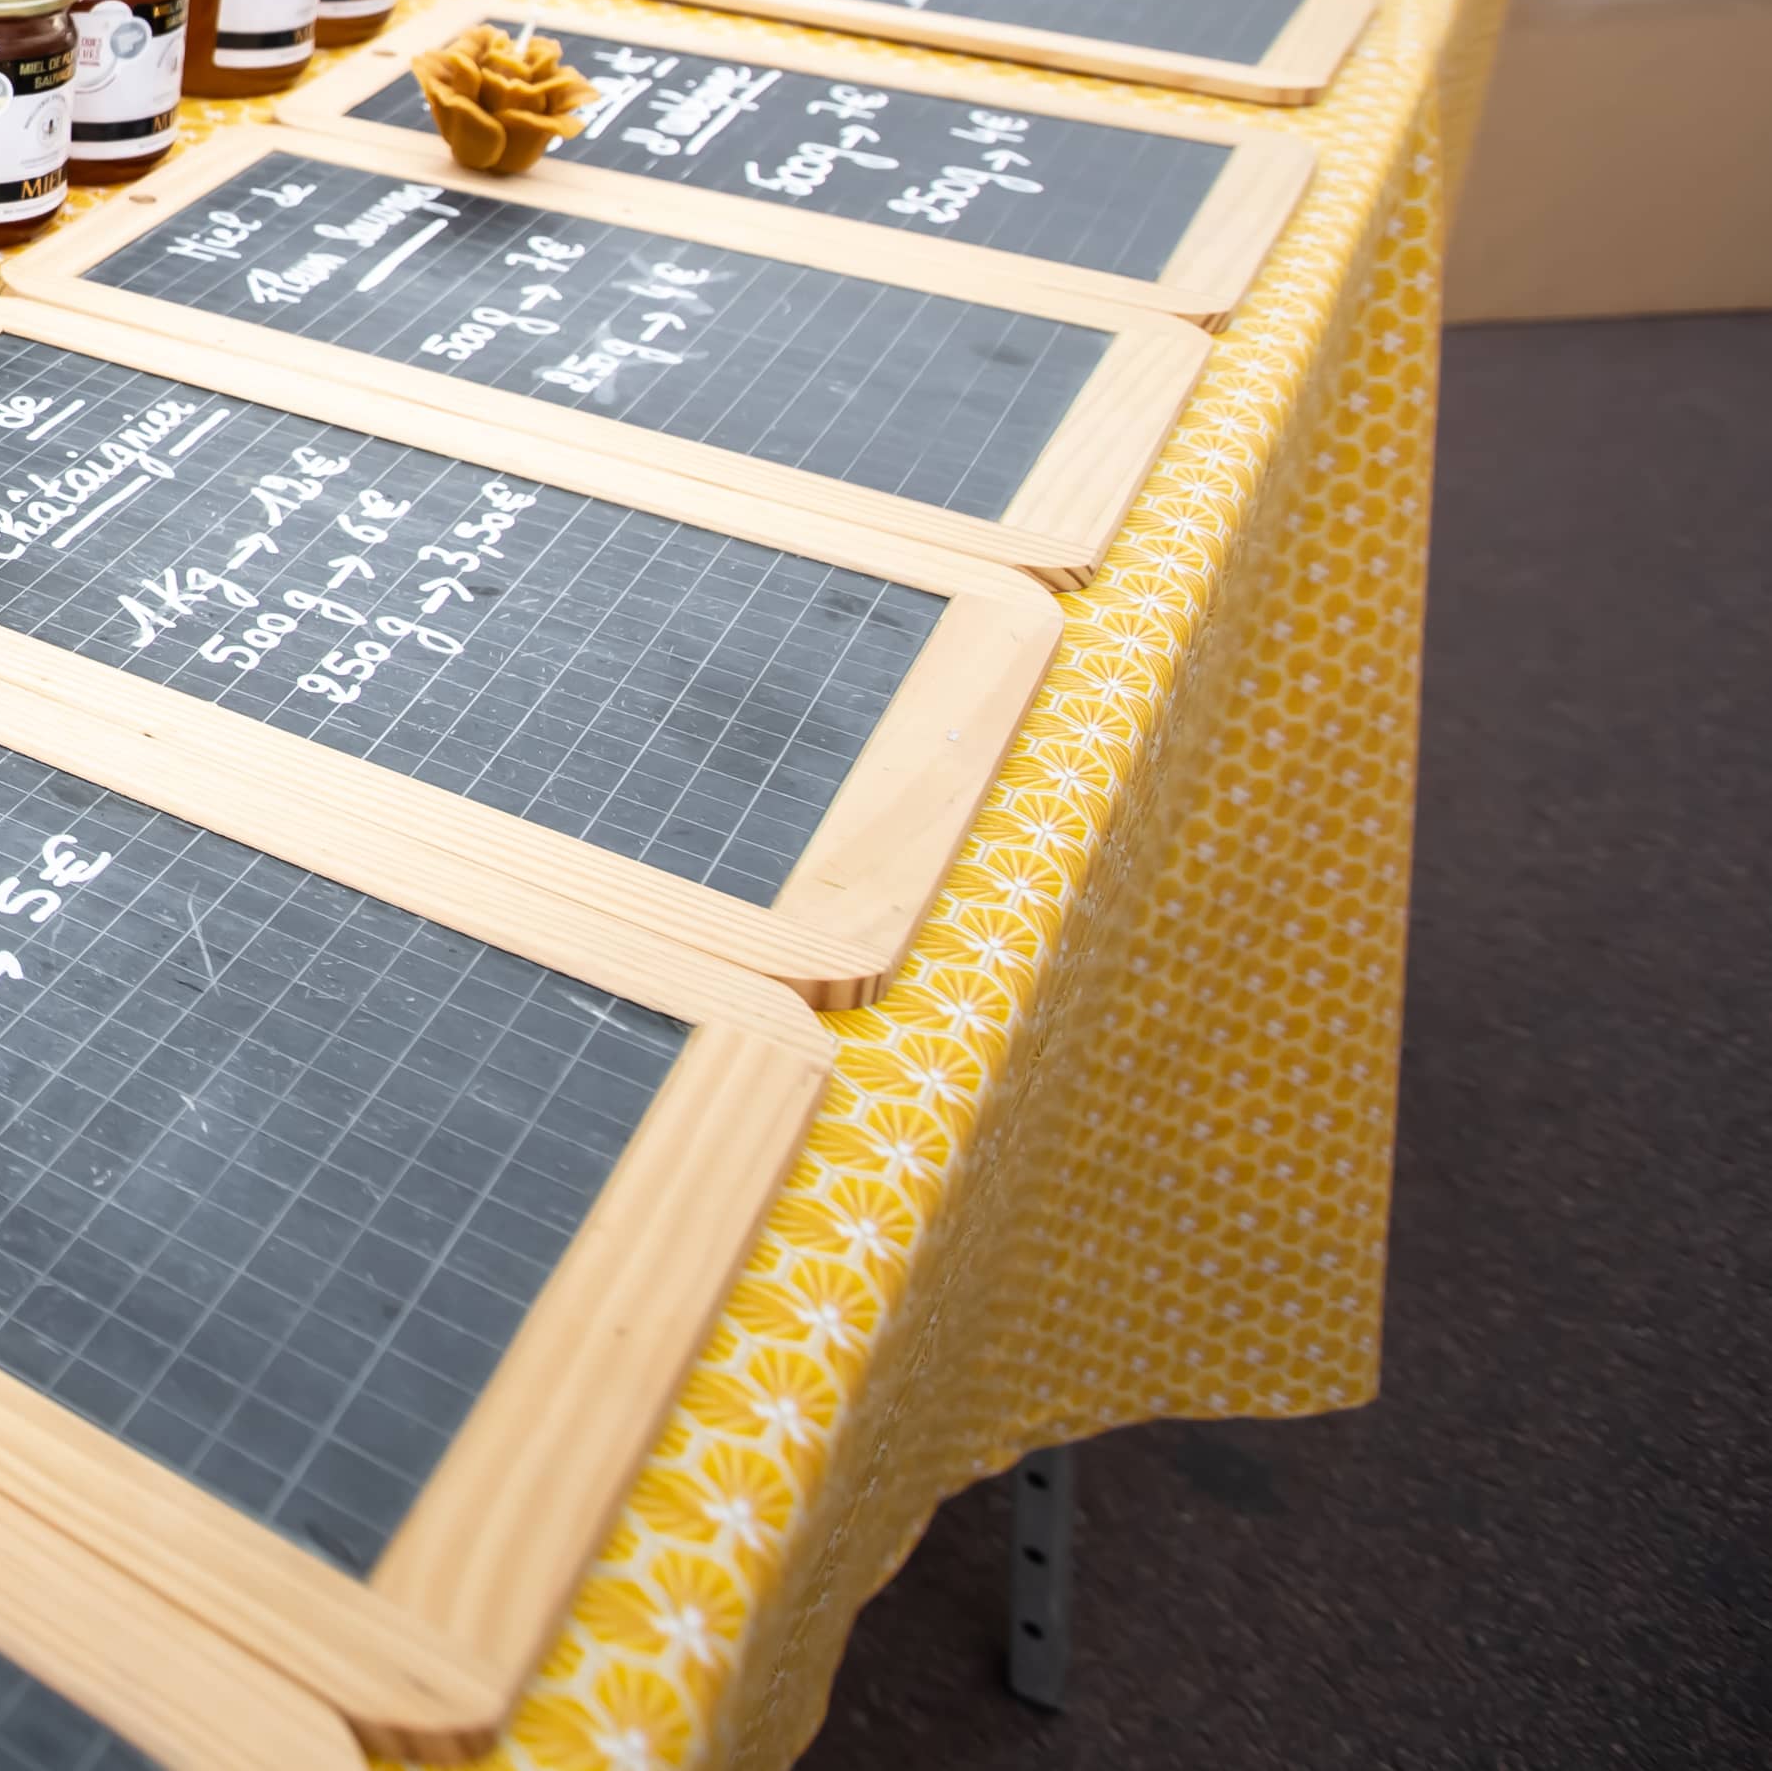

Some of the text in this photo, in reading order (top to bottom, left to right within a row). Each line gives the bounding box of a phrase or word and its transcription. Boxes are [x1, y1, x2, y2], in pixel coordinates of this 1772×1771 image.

[165, 181, 318, 262] Miel de
[421, 236, 587, 361] 500g 7€
[542, 339, 683, 395] 250g
[419, 480, 538, 576] 3,50€
